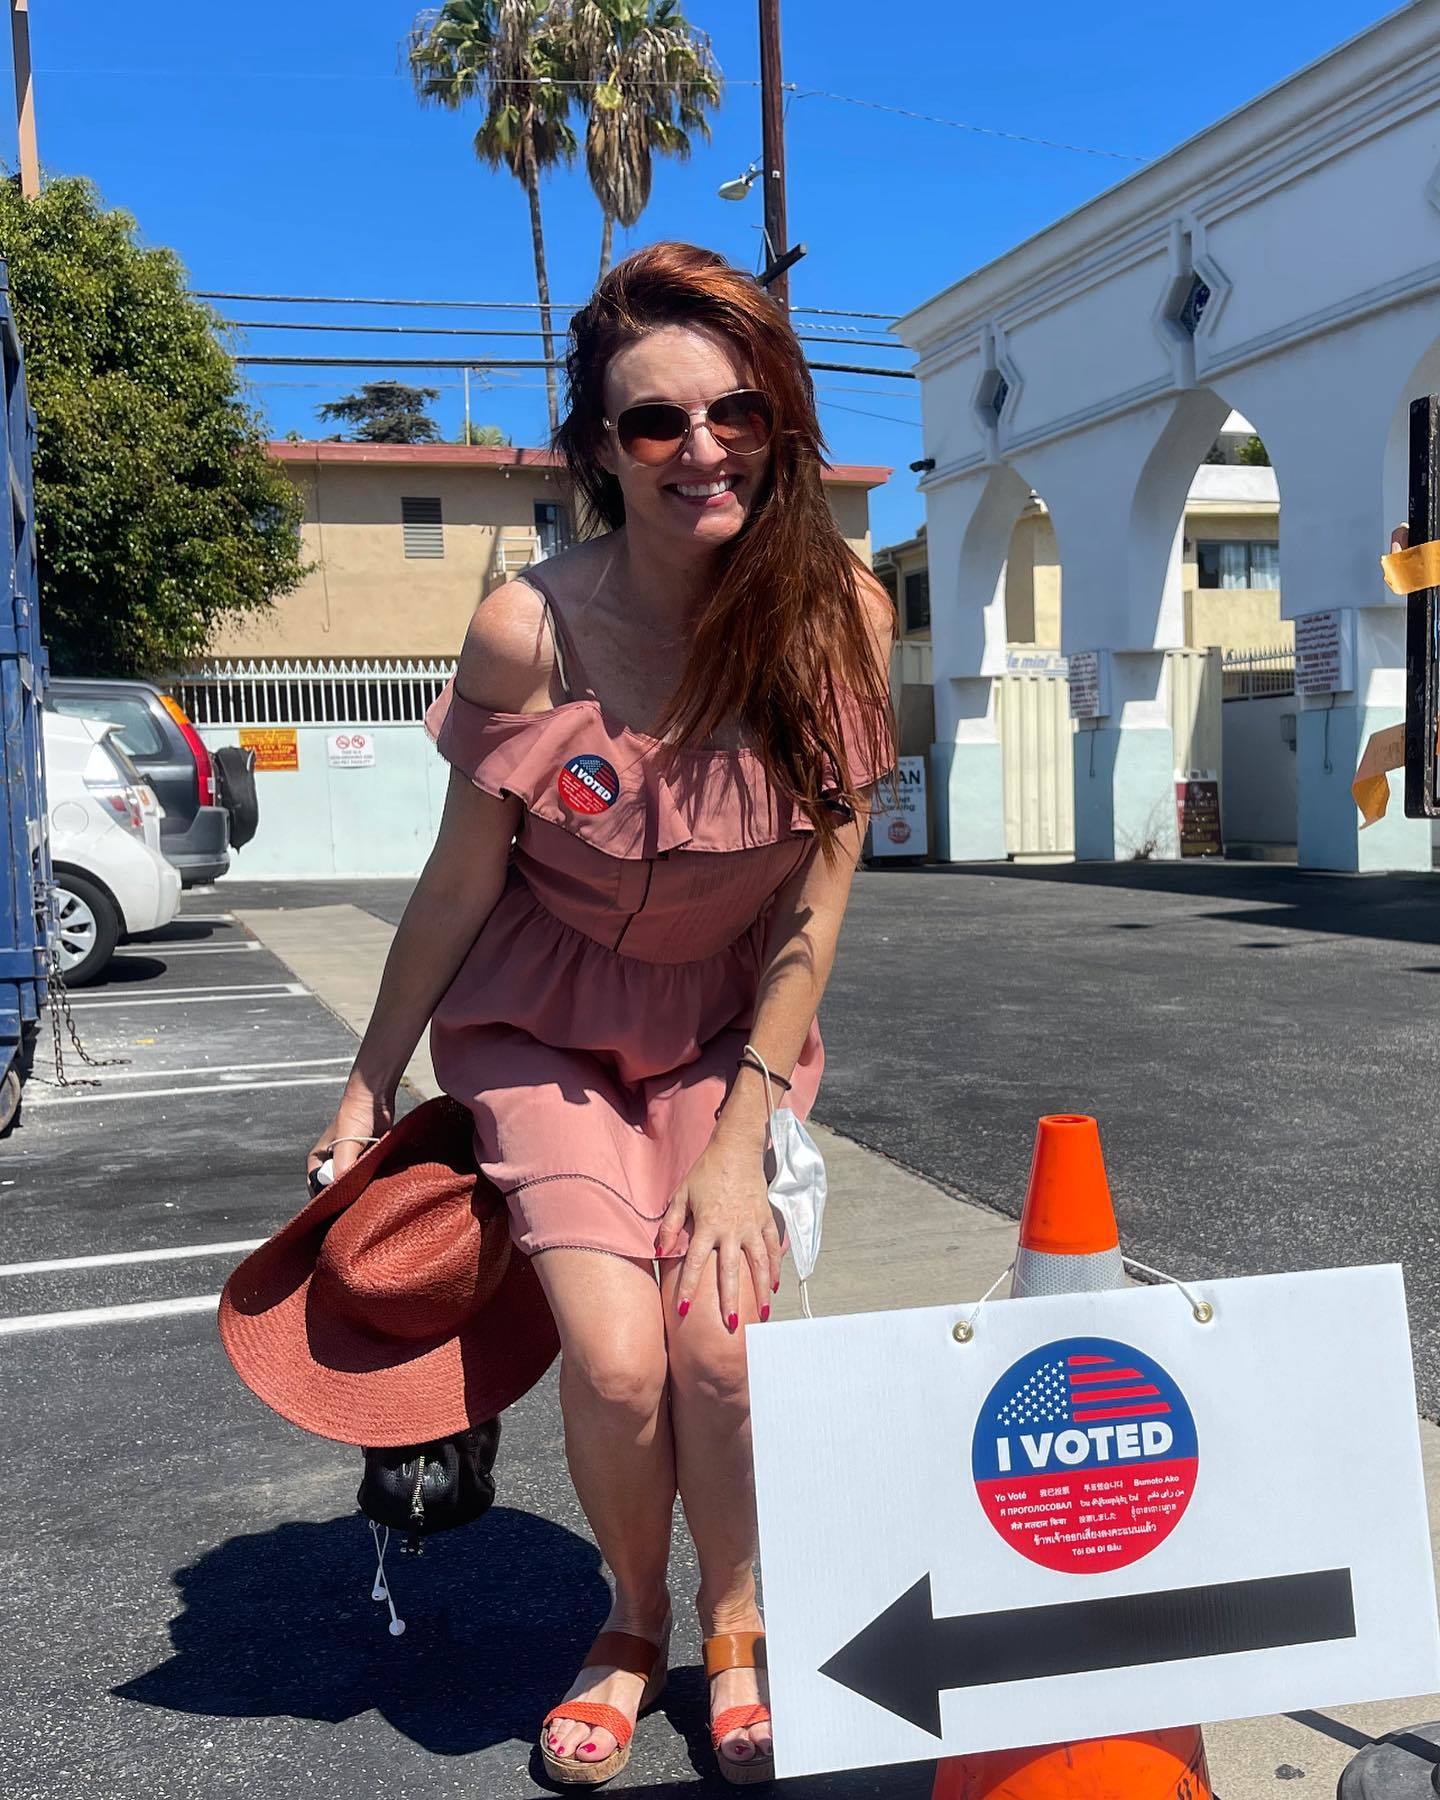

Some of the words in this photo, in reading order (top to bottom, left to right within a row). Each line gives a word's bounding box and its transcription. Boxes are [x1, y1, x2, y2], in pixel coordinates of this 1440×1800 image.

[570, 764, 579, 773] I
[577, 767, 612, 801] VOTED
[997, 1437, 1012, 1472] I
[1020, 1421, 1173, 1468] VOTED
[1134, 1476, 1163, 1487] Bumoto
[1164, 1475, 1180, 1484] Ako
[995, 1494, 1006, 1503] Yo
[1000, 1508, 1006, 1516] Я
[1007, 1501, 1072, 1516] ПРОГОЛОСОВАЛ
